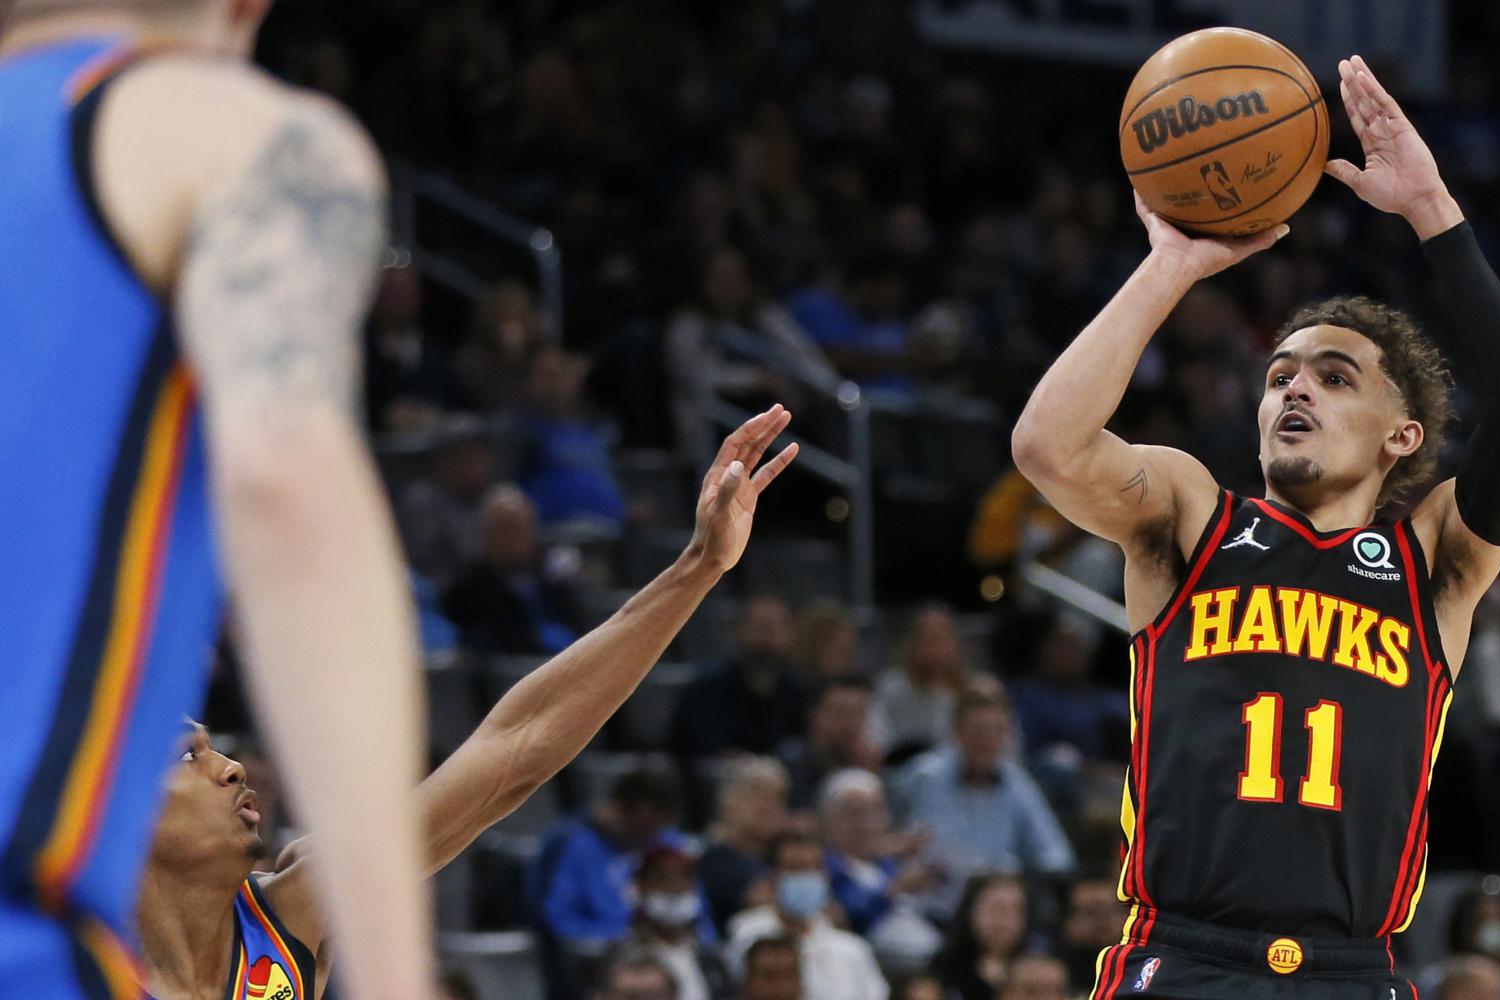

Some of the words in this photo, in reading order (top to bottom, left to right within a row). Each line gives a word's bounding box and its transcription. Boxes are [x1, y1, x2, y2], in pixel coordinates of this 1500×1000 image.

[1132, 89, 1269, 154] Wilson
[1347, 564, 1401, 581] sharecare
[1184, 585, 1411, 687] HAWKS
[1237, 691, 1342, 811] 11
[1271, 948, 1298, 964] ATL
